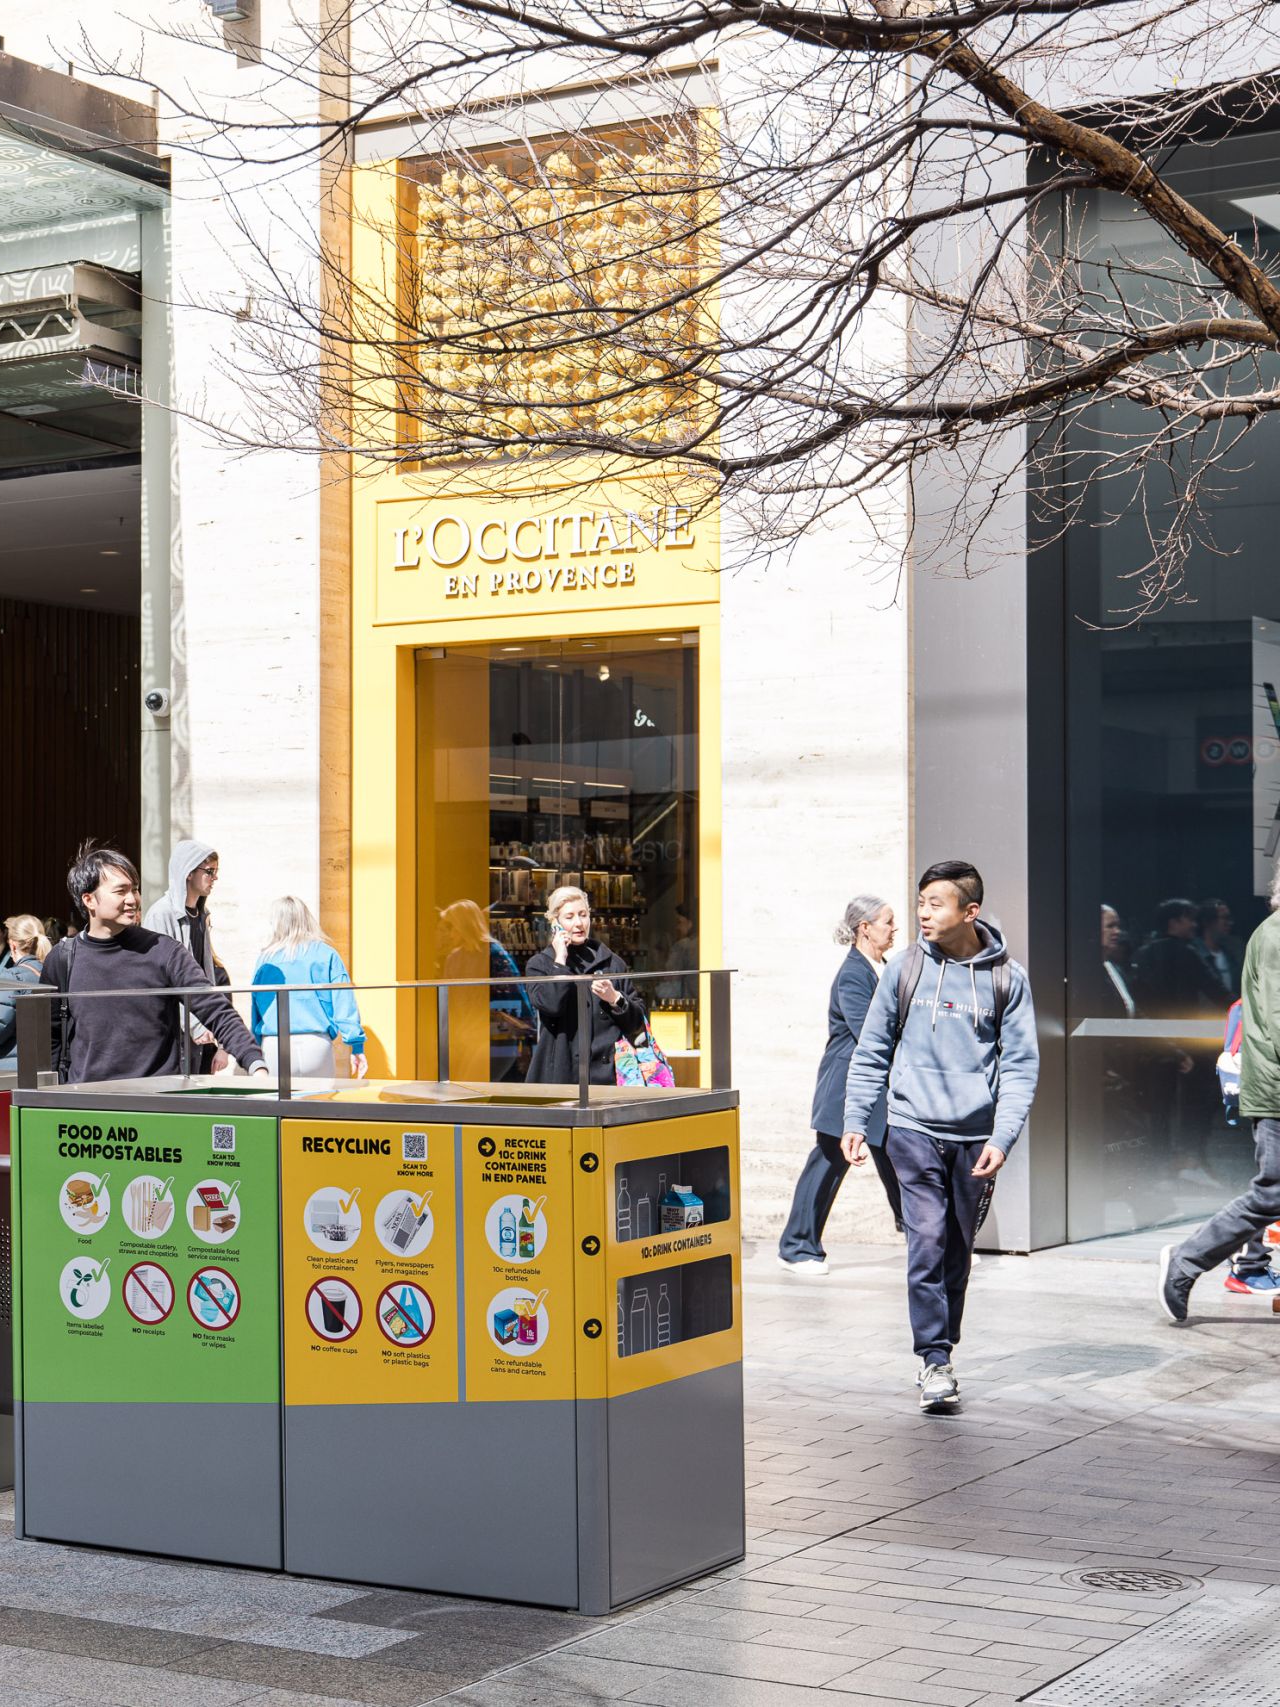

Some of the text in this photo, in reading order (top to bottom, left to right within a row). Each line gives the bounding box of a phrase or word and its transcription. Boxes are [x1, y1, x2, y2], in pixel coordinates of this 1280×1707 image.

[445, 562, 635, 598] EN PROVENCE
[58, 1124, 138, 1142] FOOD AND
[302, 1136, 391, 1155] RECYCLING
[505, 1139, 546, 1149] RECYCLE
[58, 1143, 182, 1163] COMPOSTABLES
[498, 1151, 546, 1160] 10c DRINK
[485, 1161, 546, 1173] CONTAINERS
[482, 1173, 547, 1184] IN END PANEL
[119, 1241, 156, 1250] Compostable
[652, 1242, 672, 1257] DRINK
[673, 1233, 712, 1252] CONTAINERS
[149, 1250, 179, 1258] chopsticks
[187, 1245, 225, 1255] Compostable
[187, 1253, 207, 1261] service
[306, 1255, 324, 1263] Clean
[325, 1256, 345, 1265] plastic
[322, 1264, 355, 1272] containers
[375, 1260, 434, 1270] Flyers, newspapers
[505, 1267, 540, 1275] refundable
[505, 1274, 528, 1282] bottles
[66, 1321, 104, 1330] Items labelled
[67, 1329, 103, 1338] compostable
[142, 1328, 165, 1336] receipts
[203, 1333, 215, 1341] face
[216, 1335, 235, 1343] masks
[208, 1341, 226, 1349] wipes
[322, 1345, 341, 1353] coffee
[406, 1351, 431, 1360] plastics
[391, 1358, 412, 1367] plastic
[413, 1359, 429, 1368] bags
[506, 1360, 542, 1368] refundable
